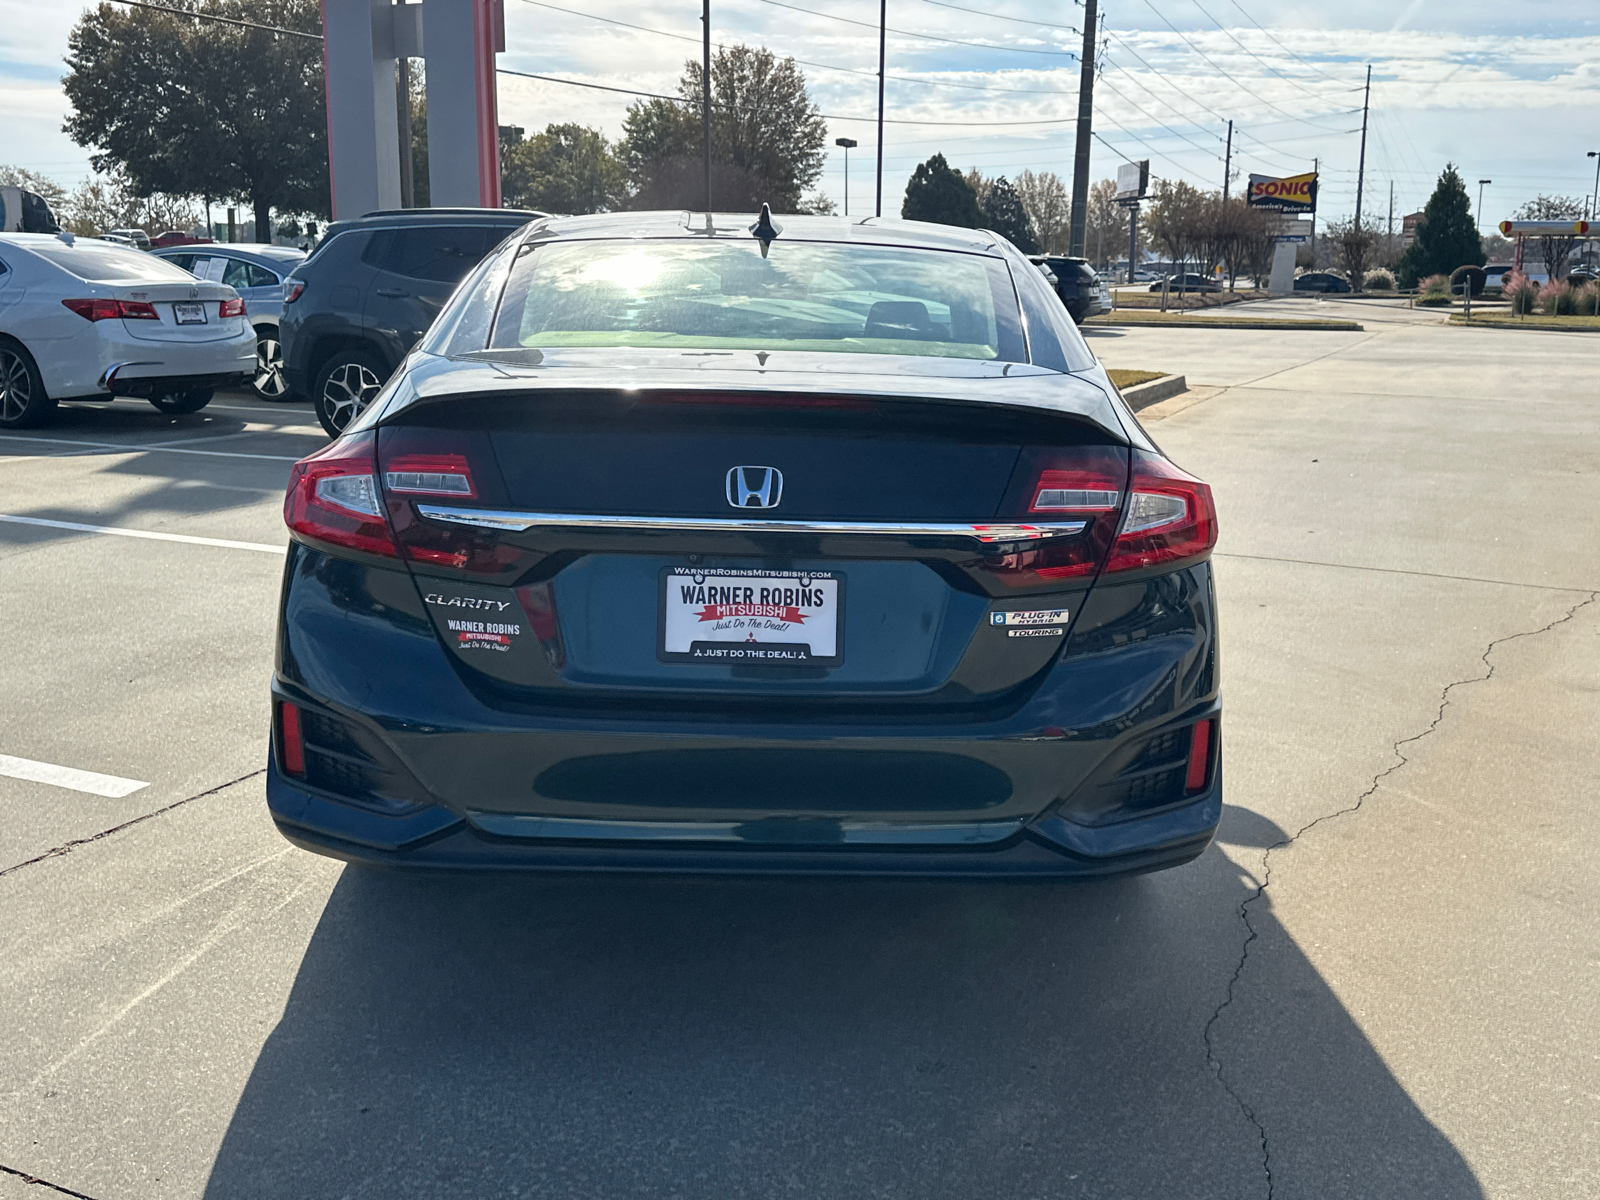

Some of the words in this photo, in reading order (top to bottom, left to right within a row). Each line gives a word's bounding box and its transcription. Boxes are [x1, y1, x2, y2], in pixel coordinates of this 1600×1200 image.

[1253, 182, 1311, 196] SONIC
[424, 593, 511, 612] CLARITY
[680, 585, 754, 605] WARNER
[760, 587, 824, 607] ROBINS
[716, 605, 787, 618] MITSUBISHI
[1012, 611, 1062, 619] PLUG-IN
[447, 619, 484, 633] WARNER
[486, 623, 520, 636] ROBINS
[712, 619, 732, 631] Just
[733, 618, 745, 628] Do
[748, 618, 762, 628] The
[763, 622, 790, 632] Deal!
[466, 633, 502, 642] MITSUBISHI
[458, 641, 471, 649] Just
[704, 649, 728, 657] JUST
[730, 650, 745, 658] DO
[746, 650, 765, 658] THE
[767, 651, 797, 659] DEAL!
